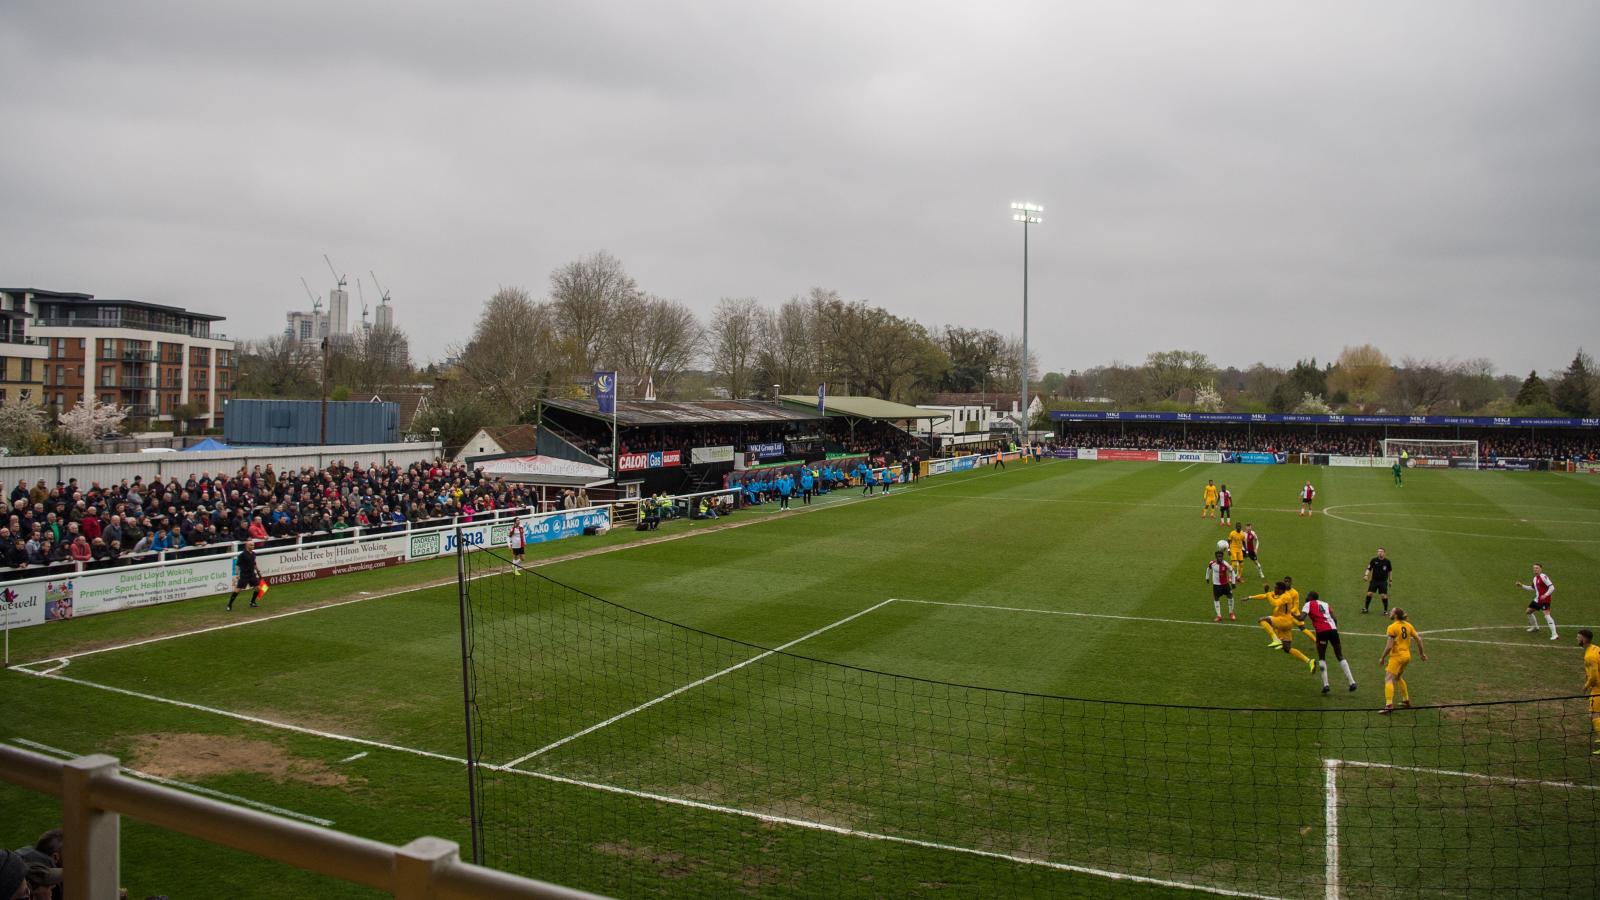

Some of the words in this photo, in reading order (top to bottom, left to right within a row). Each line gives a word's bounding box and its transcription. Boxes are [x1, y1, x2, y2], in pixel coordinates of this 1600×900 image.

[619, 455, 647, 469] CALOR
[650, 454, 661, 467] Gas
[531, 523, 549, 535] JAKO
[562, 518, 580, 530] JAKO
[336, 545, 359, 556] Hilton
[361, 542, 388, 553] Woking
[120, 573, 142, 583] David
[143, 570, 165, 580] Lloyd
[166, 567, 193, 577] Woking
[270, 575, 291, 585] 01483
[292, 571, 316, 582] 221000
[80, 587, 113, 599] Premier
[140, 578, 167, 589] Health
[168, 577, 182, 586] and
[183, 574, 209, 585] Leisure
[210, 571, 228, 581] Club
[1401, 626, 1408, 639] 8
